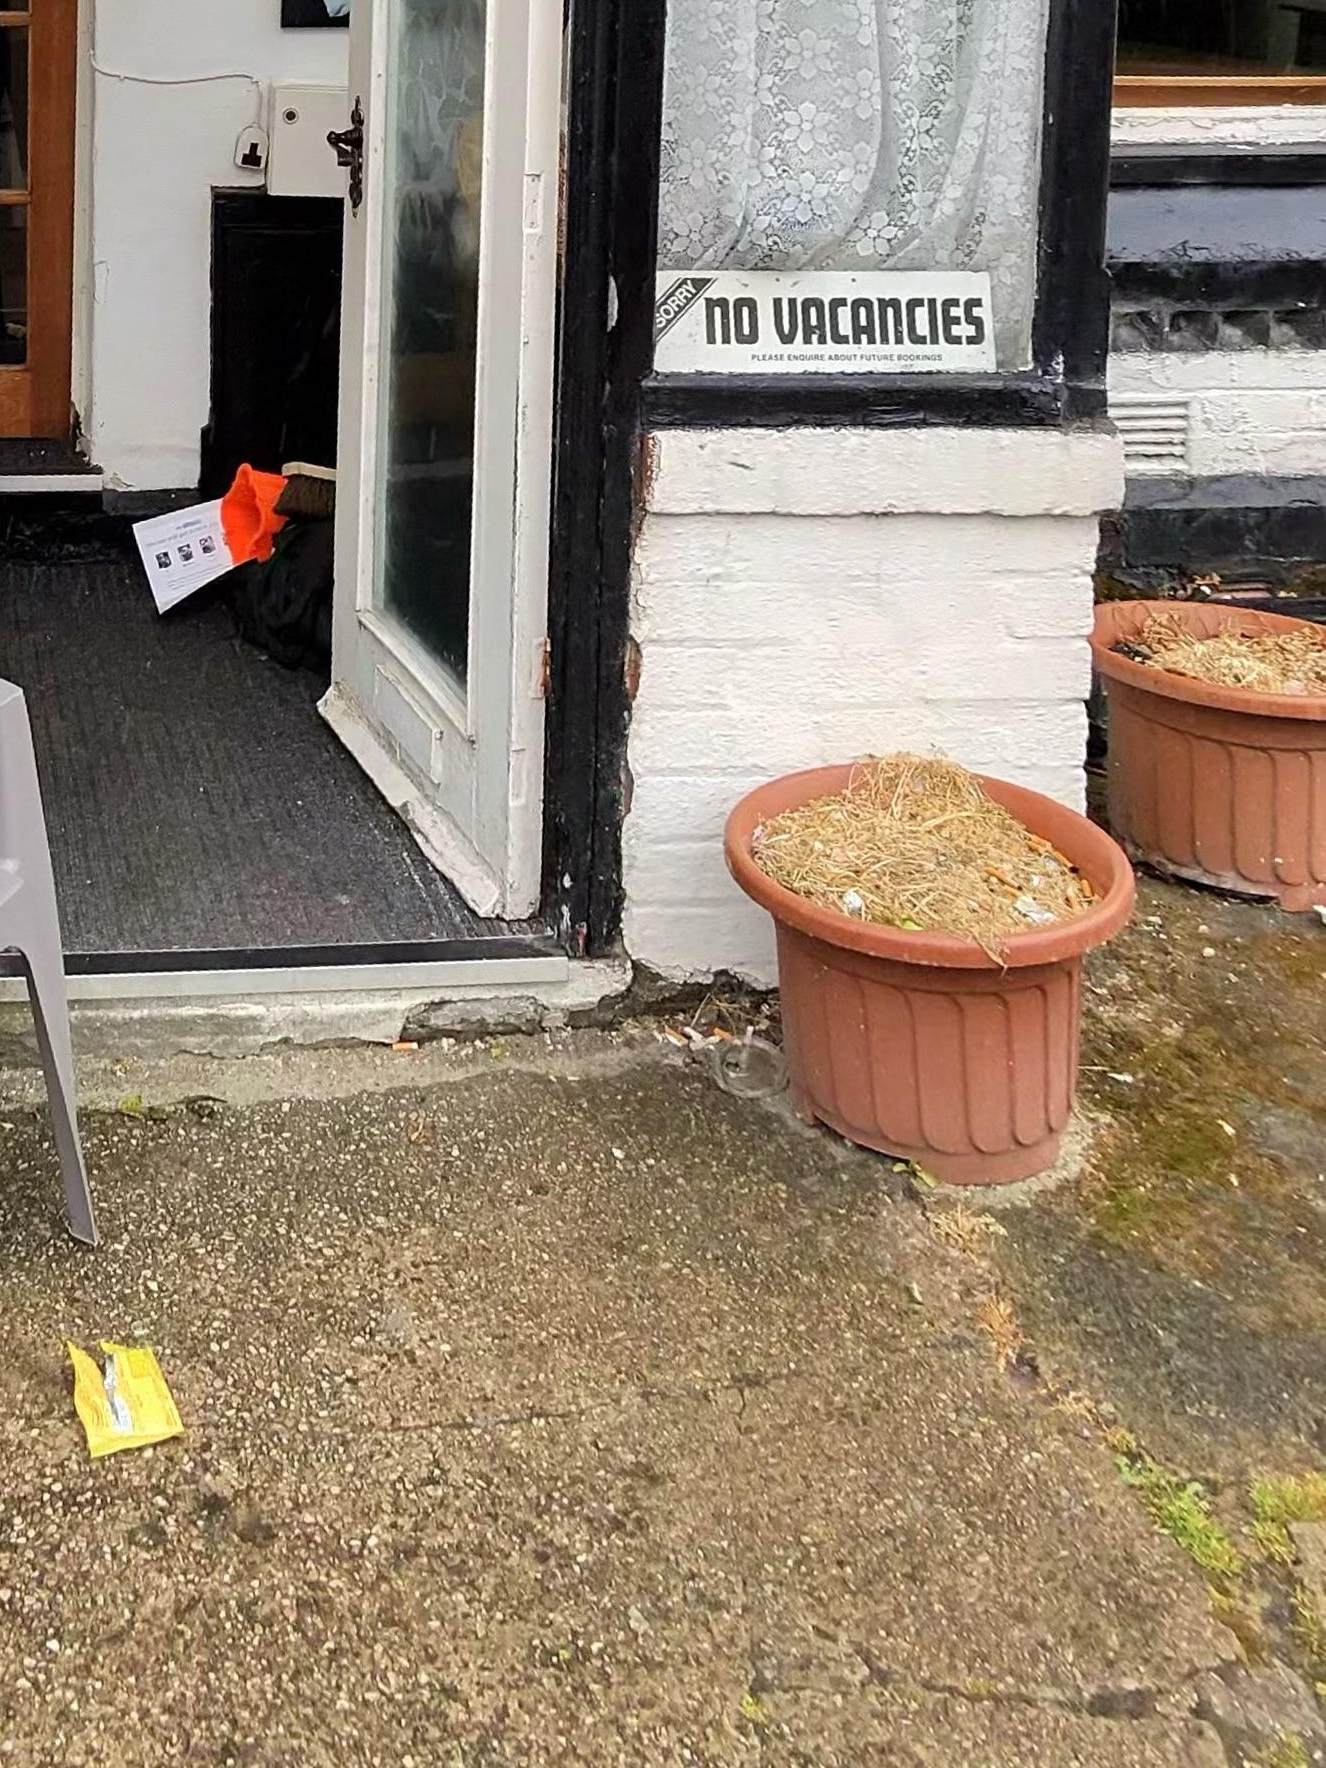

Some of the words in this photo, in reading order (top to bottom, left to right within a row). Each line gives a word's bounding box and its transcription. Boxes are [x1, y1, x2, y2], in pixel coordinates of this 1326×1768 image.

[655, 279, 697, 328] SORRY
[704, 296, 759, 346] NO
[773, 296, 986, 346] VACANCIES
[751, 353, 785, 362] PLEASE
[787, 353, 825, 362] ENQUIRE
[827, 353, 858, 362] ABOUT
[860, 353, 895, 362] FUTURE
[896, 353, 943, 362] BOOKINGS
